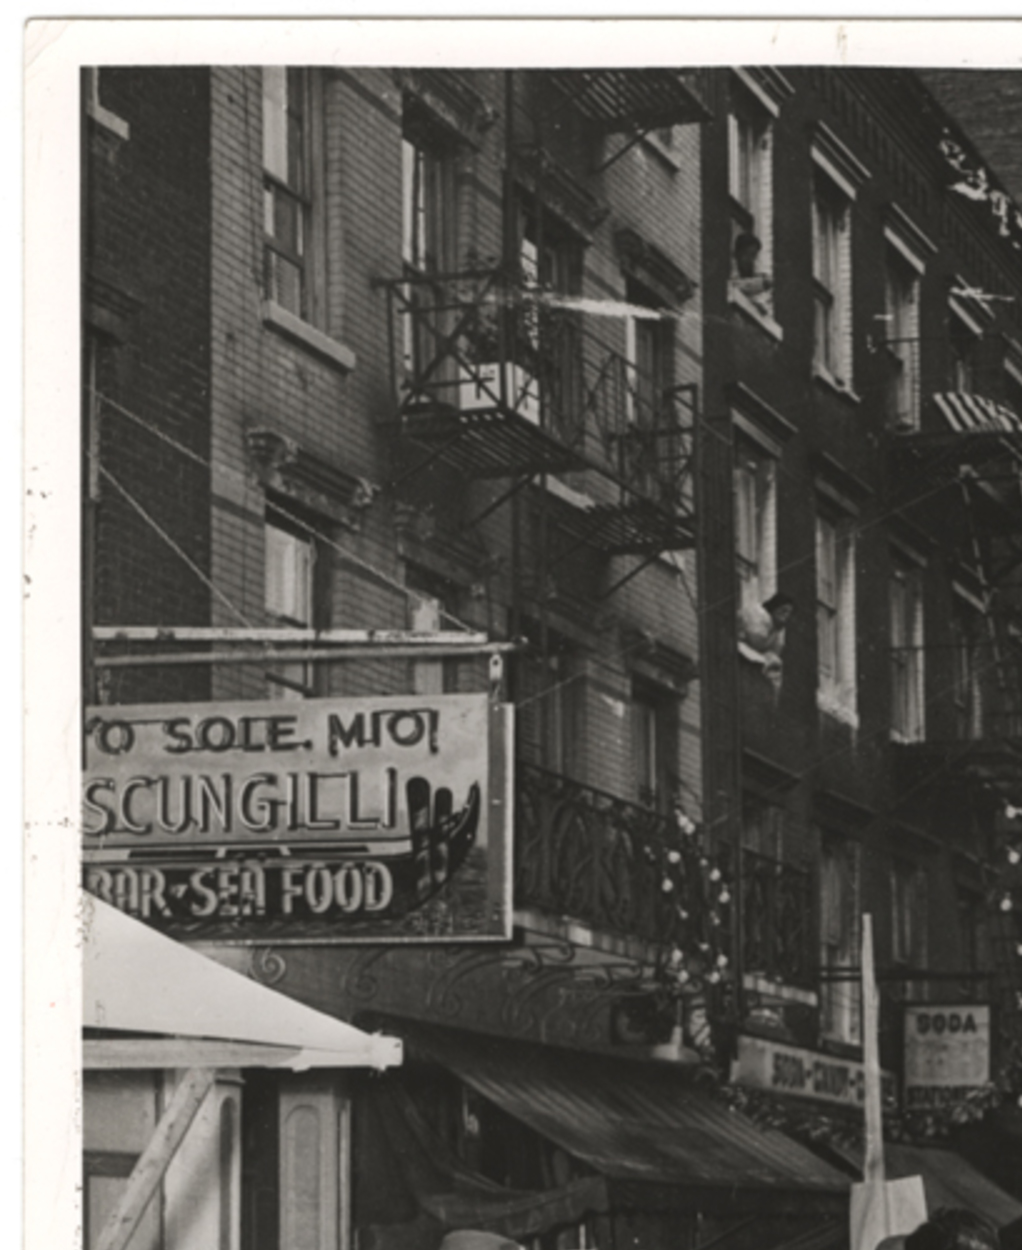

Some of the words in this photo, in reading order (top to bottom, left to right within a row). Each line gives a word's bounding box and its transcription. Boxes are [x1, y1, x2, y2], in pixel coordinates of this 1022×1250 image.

[81, 767, 398, 837] SCUNGILLI
[281, 860, 393, 914] FOOD
[916, 1012, 978, 1036] SODA
